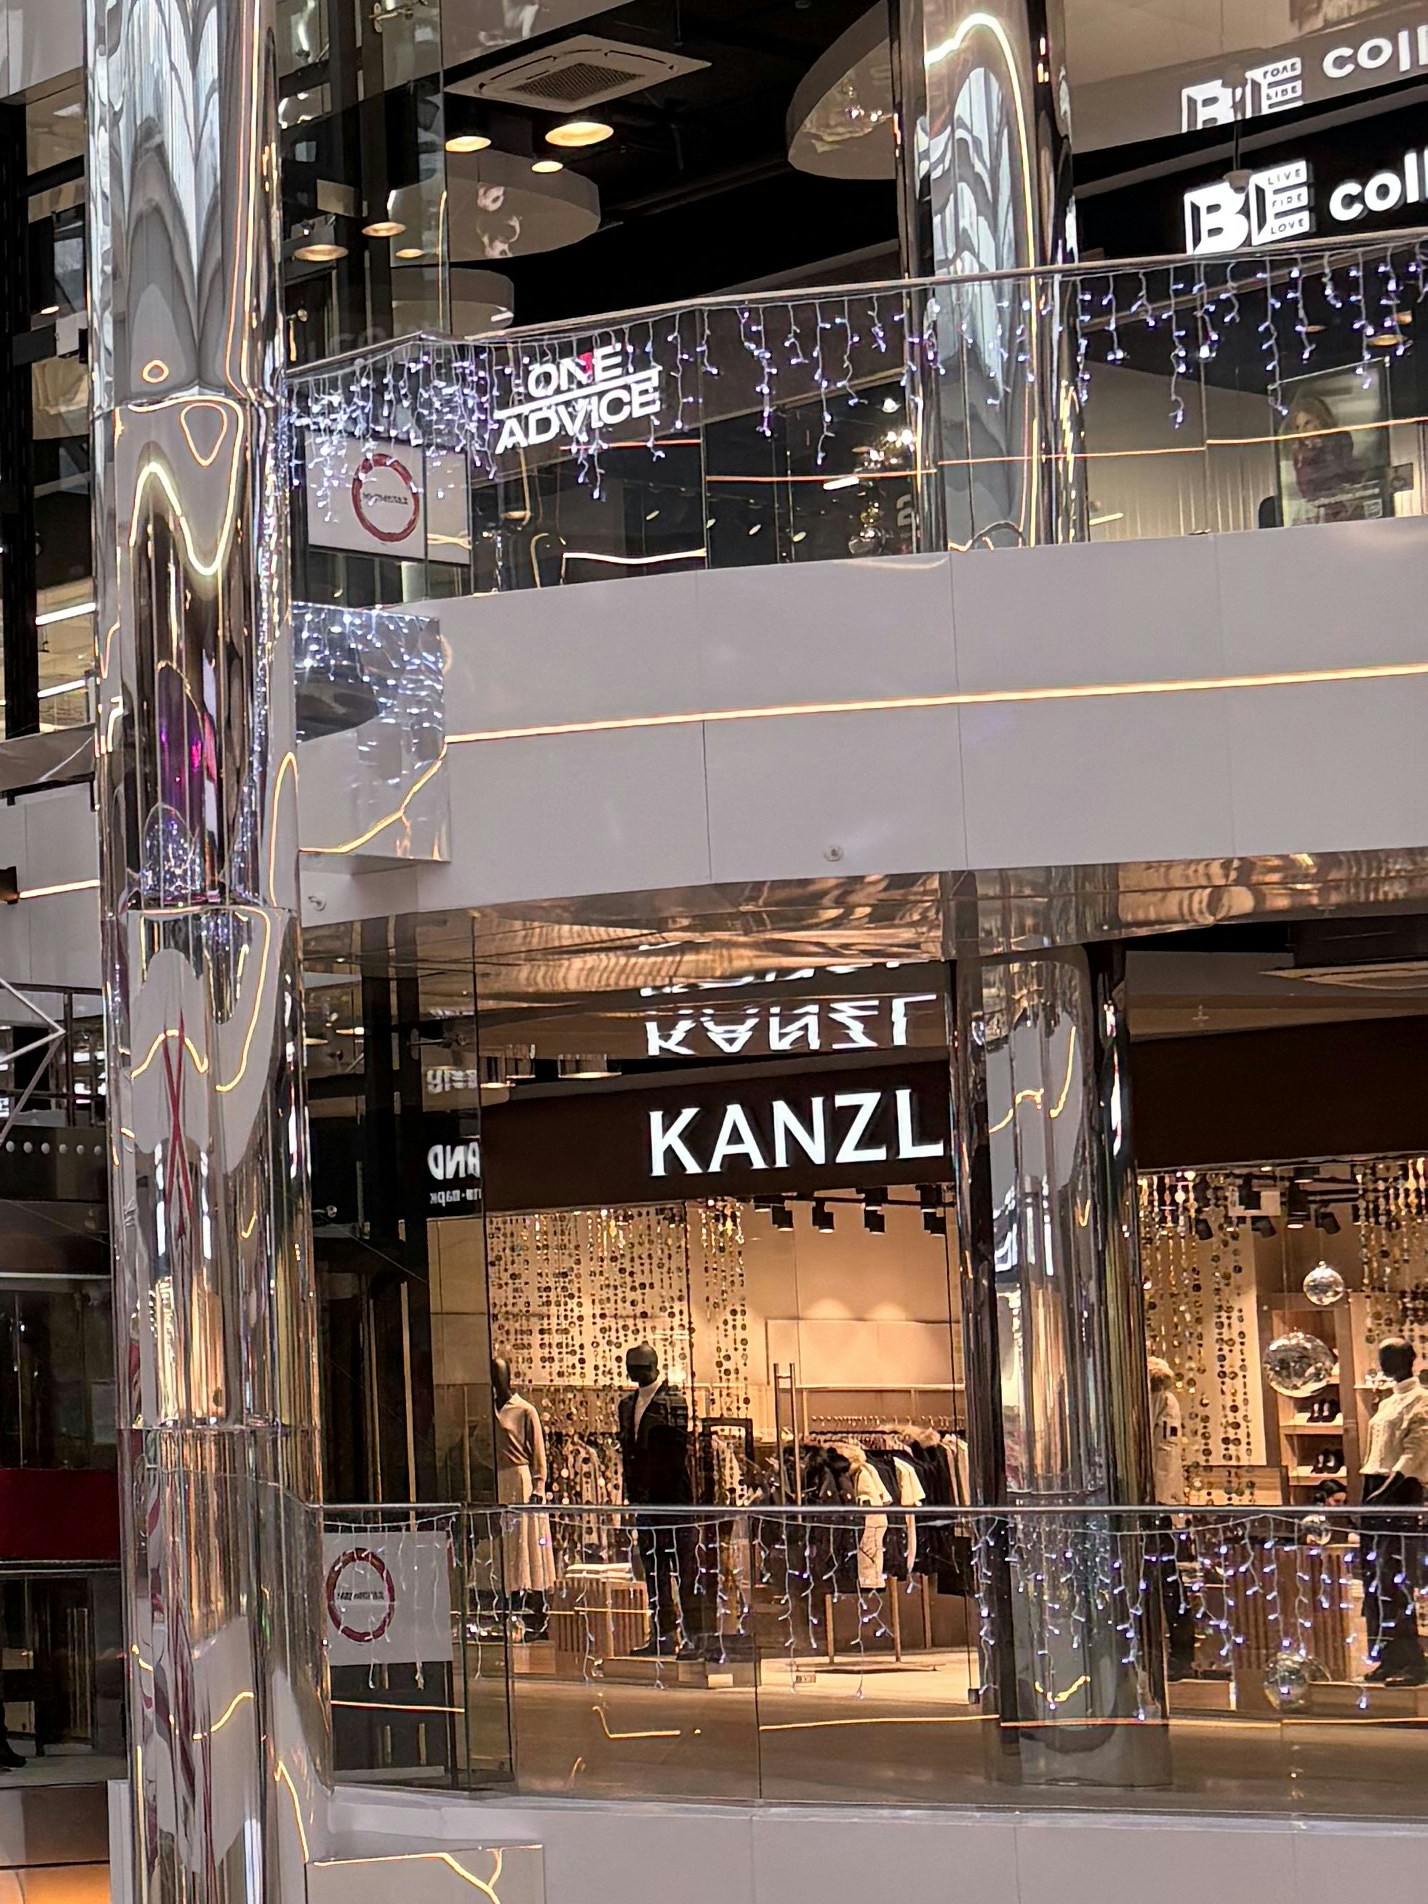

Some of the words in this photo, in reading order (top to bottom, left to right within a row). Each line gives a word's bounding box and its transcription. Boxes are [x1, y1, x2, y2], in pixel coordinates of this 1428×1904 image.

[1270, 217, 1305, 235] LOVE
[527, 343, 624, 398] ONE
[495, 379, 662, 455] ADVICE
[649, 1088, 945, 1179] KANZL
